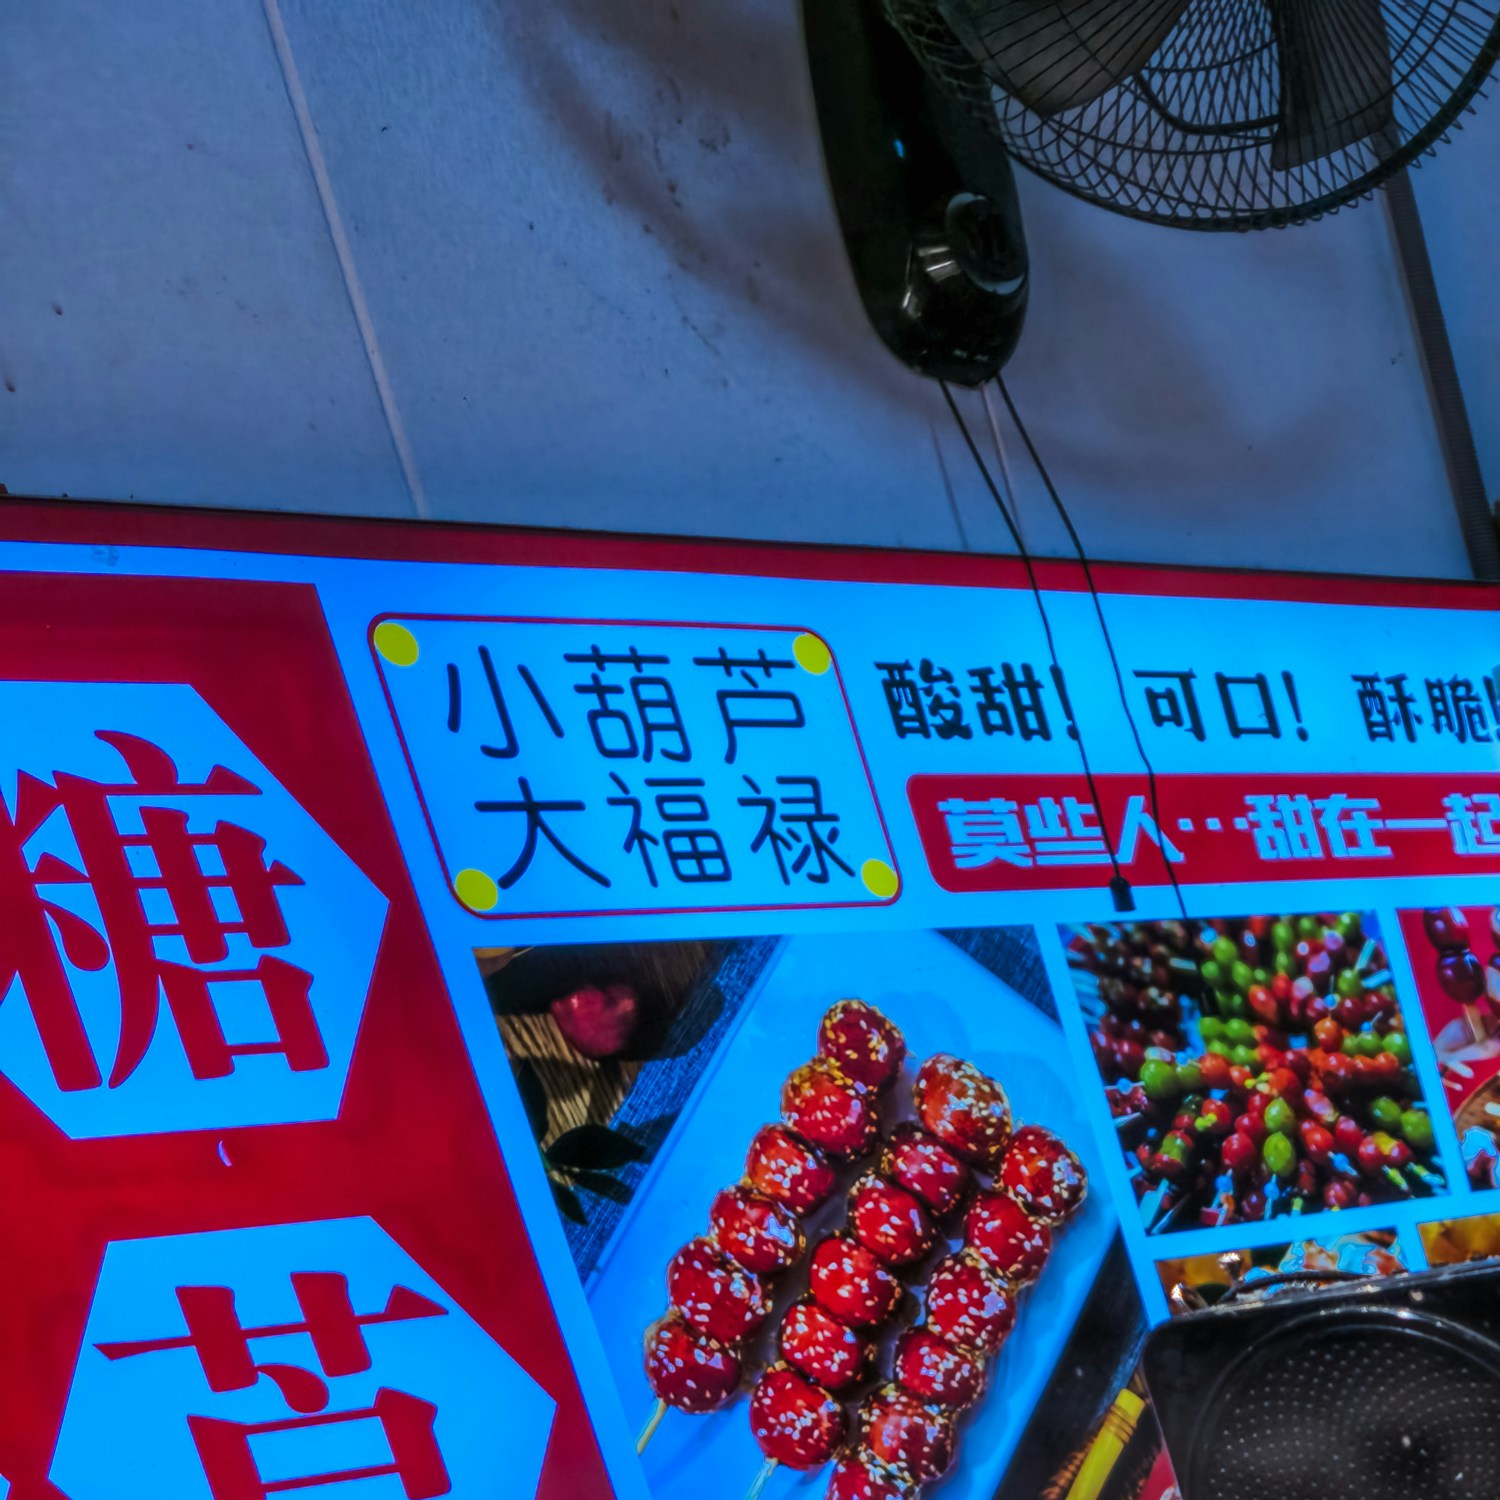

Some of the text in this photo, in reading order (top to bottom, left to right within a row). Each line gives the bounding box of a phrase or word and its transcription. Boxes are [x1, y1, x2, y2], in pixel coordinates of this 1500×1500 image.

[447, 644, 806, 765] 小葫芦
[473, 771, 856, 890] 大福禄
[0, 729, 331, 1096] 糖
